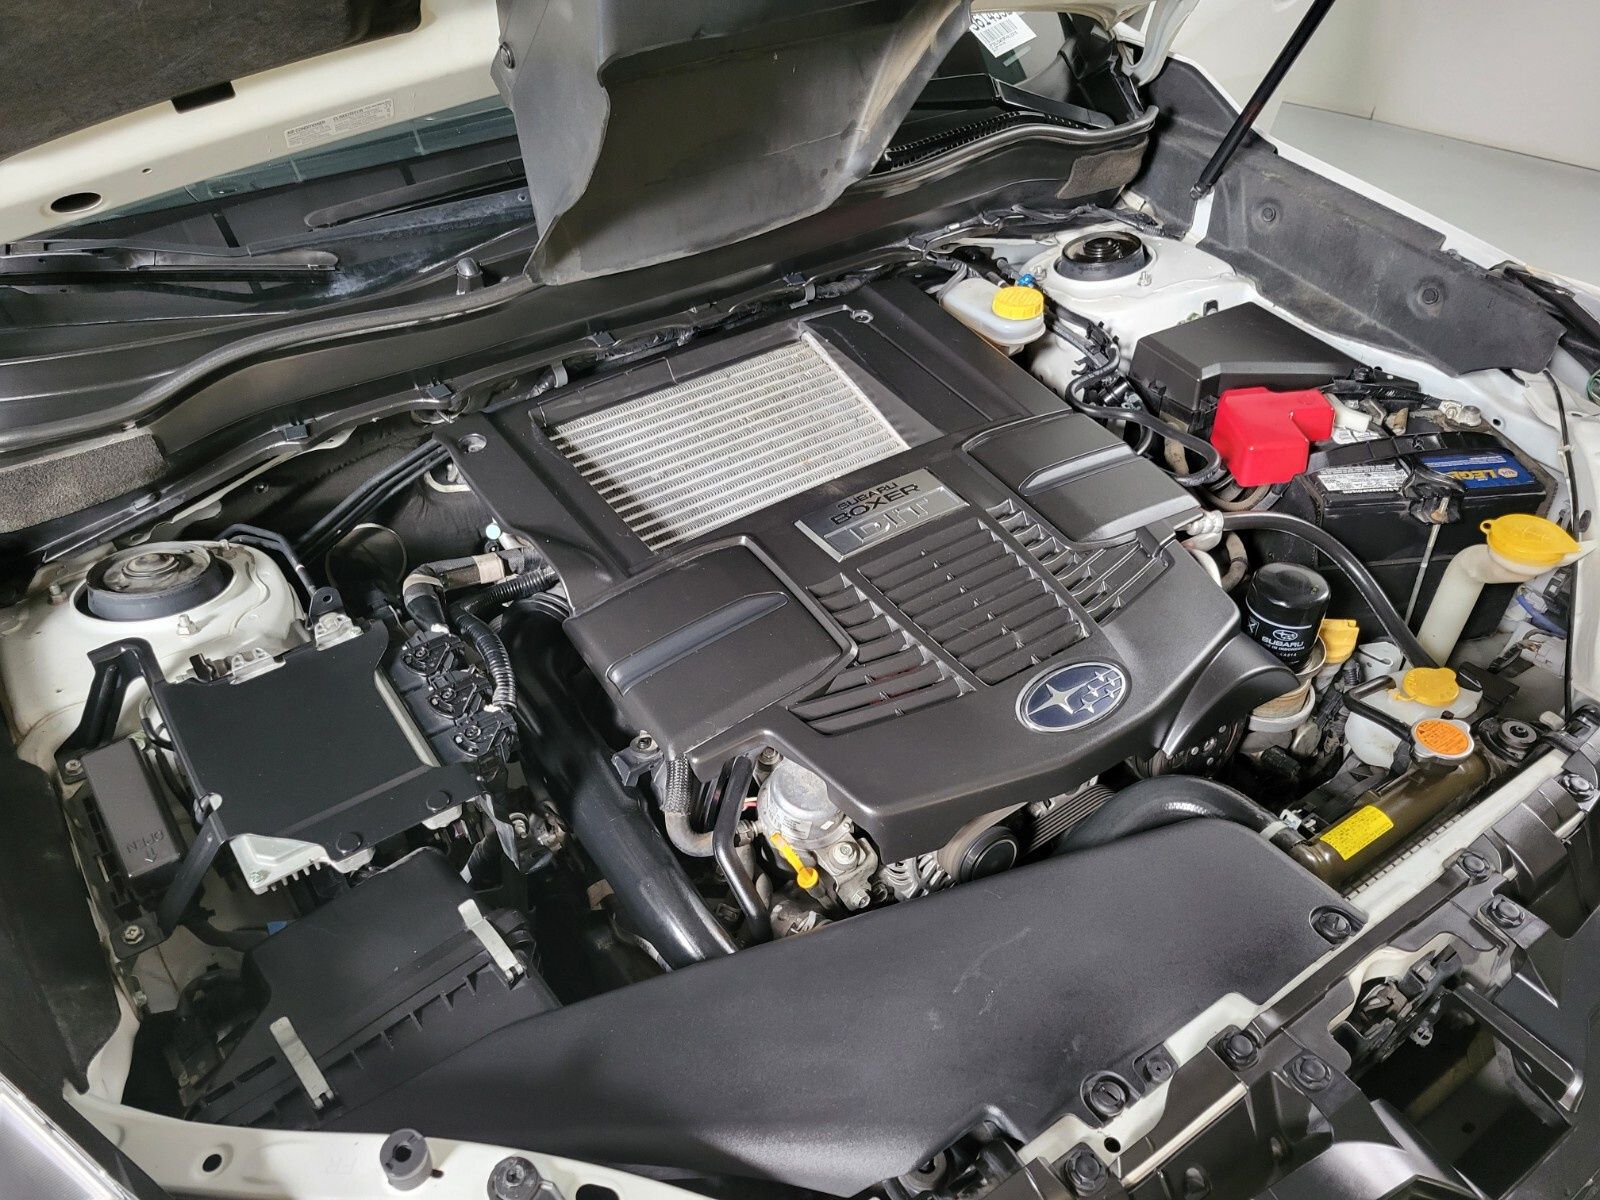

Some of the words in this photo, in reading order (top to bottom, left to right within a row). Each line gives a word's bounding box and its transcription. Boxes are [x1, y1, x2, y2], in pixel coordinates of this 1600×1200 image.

[830, 483, 920, 525] BOXER
[837, 481, 898, 511] SUBARU
[849, 497, 930, 544] DIT
[1261, 636, 1304, 648] SUBARU
[126, 829, 165, 853] OPEN
